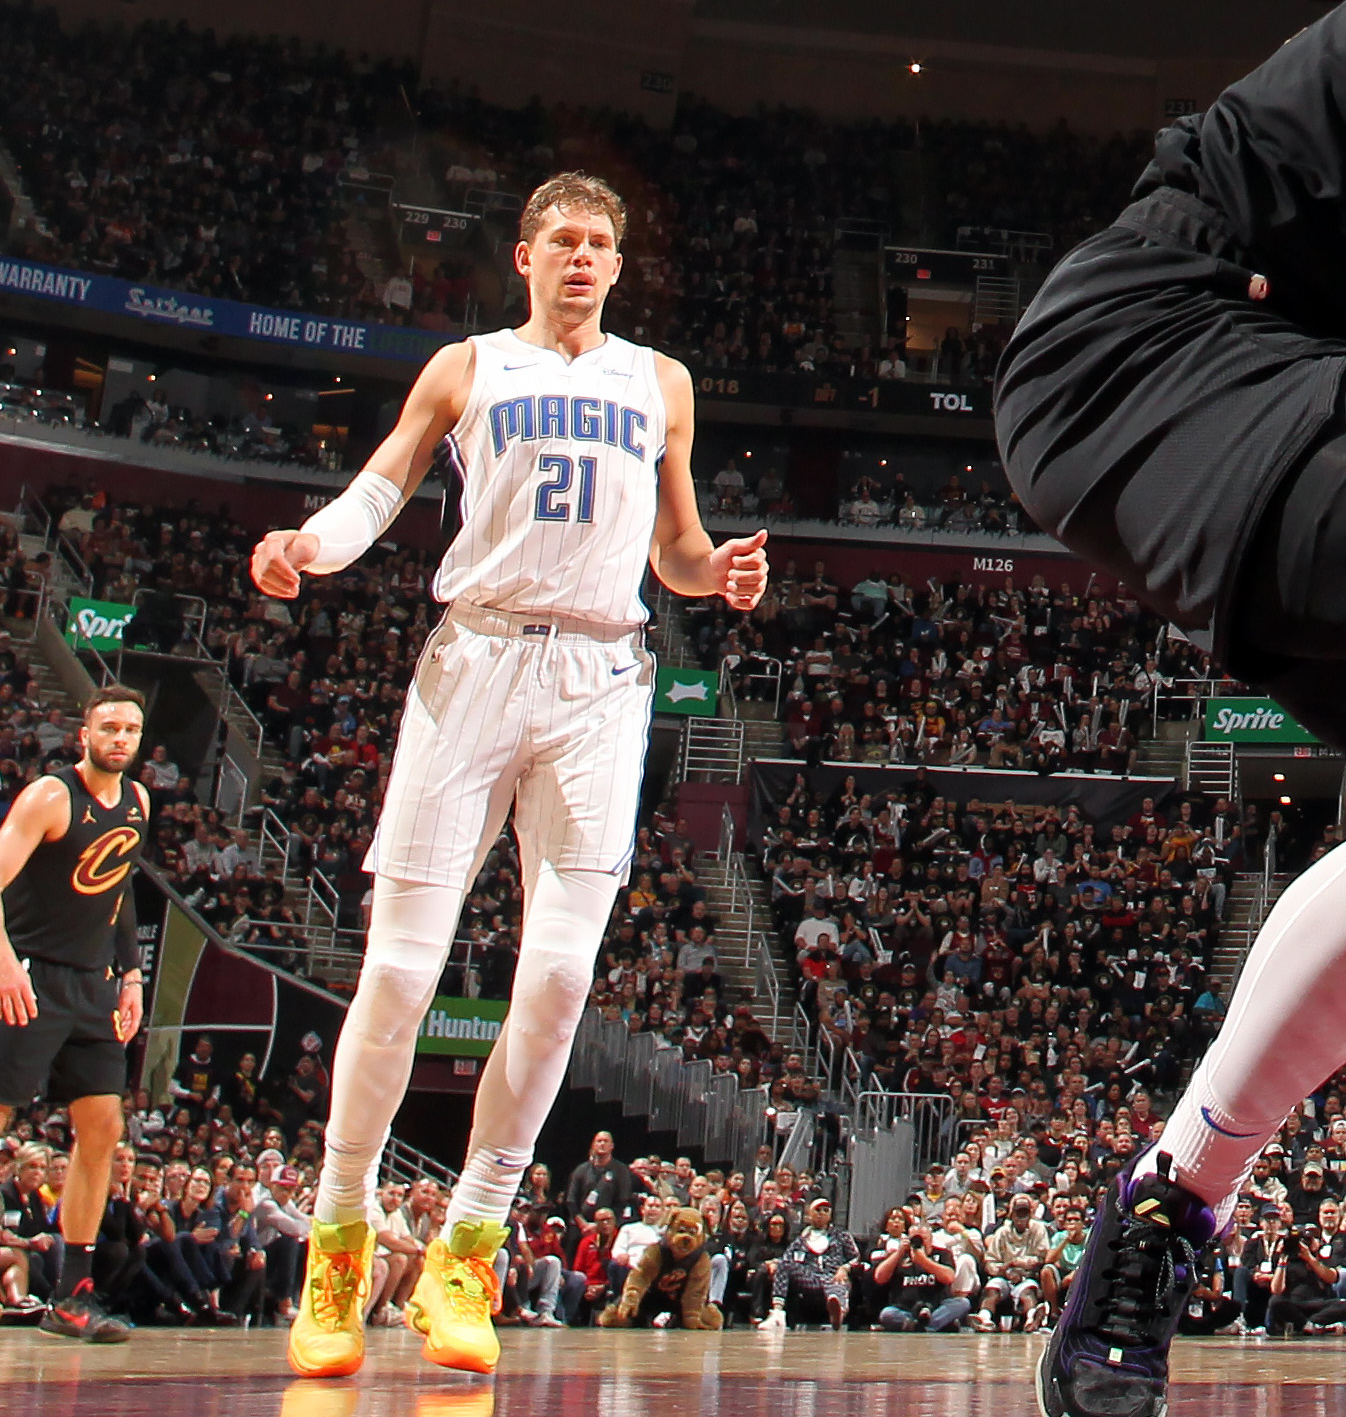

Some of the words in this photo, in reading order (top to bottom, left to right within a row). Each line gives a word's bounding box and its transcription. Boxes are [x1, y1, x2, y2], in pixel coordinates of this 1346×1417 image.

[443, 217, 467, 229] 230
[895, 253, 917, 264] 230
[250, 312, 299, 340] HOME
[305, 321, 327, 343] OF
[333, 324, 366, 349] THE
[930, 392, 973, 411] TOL
[489, 395, 647, 462] MAGIC
[534, 454, 597, 523] 21
[973, 557, 1014, 573] M126
[73, 604, 134, 642] Spri
[1212, 707, 1285, 734] Sprite
[427, 1010, 501, 1040] Huntin
